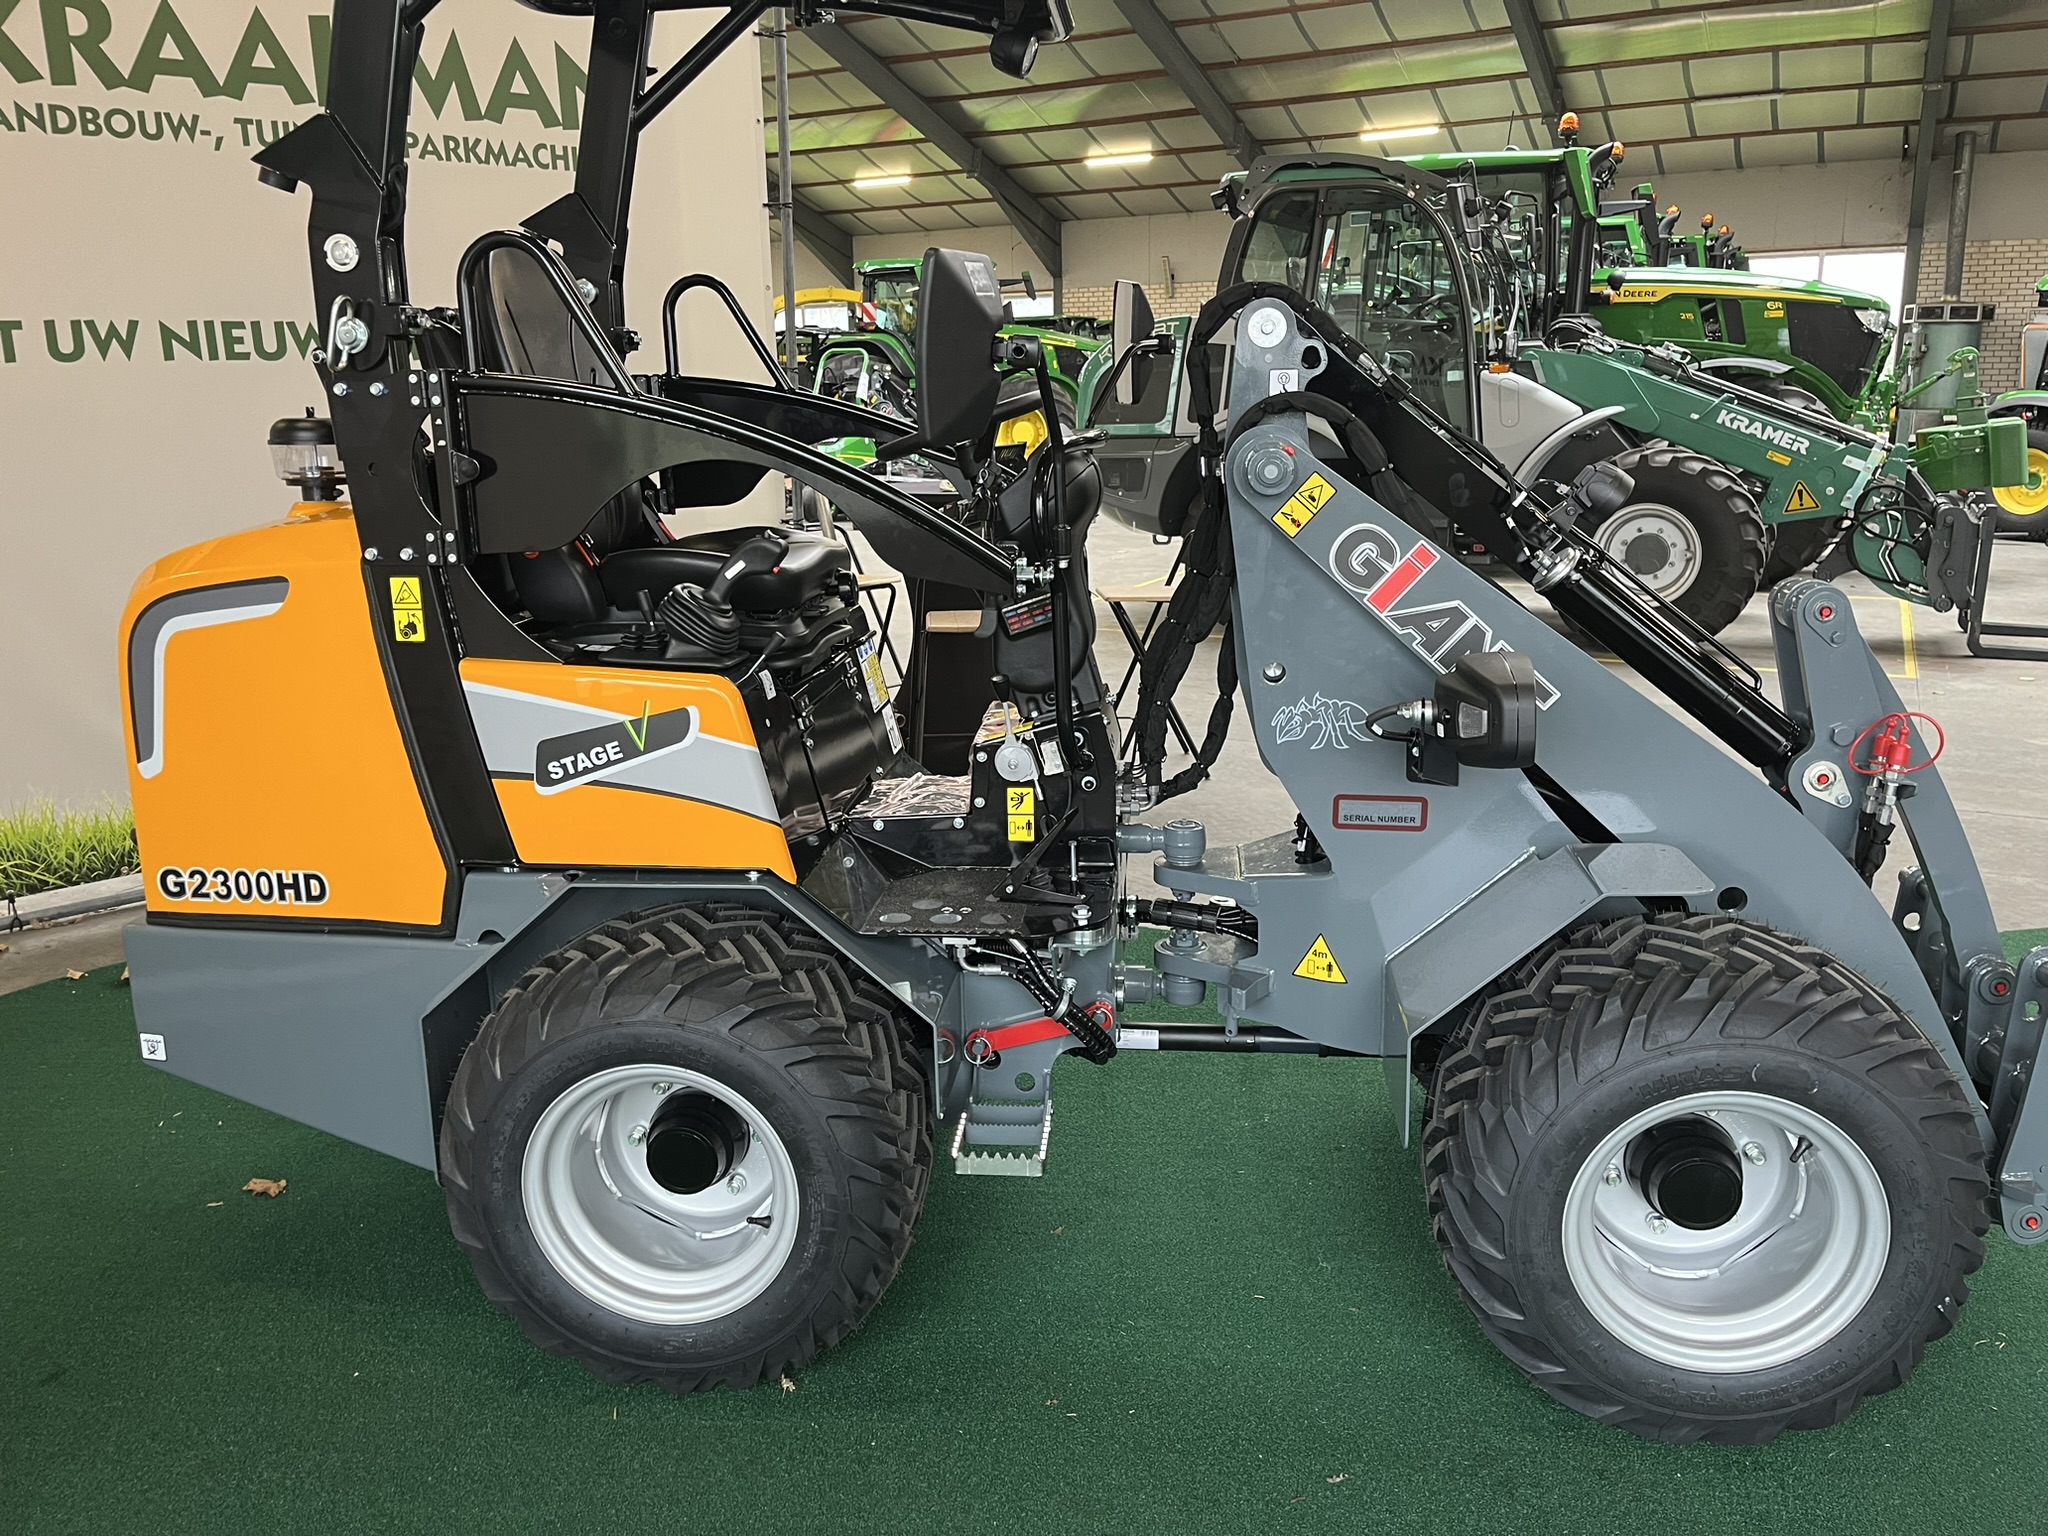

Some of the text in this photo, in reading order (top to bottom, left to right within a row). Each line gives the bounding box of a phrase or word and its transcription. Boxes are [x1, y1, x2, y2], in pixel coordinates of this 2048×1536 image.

[1623, 289, 1658, 298] DEERE
[1766, 300, 1783, 310] 6R
[43, 319, 139, 363] UW
[1716, 409, 1810, 455] KRAMER
[547, 740, 624, 780] STAGE
[1343, 814, 1416, 824] SERIAL NUMBER
[158, 867, 328, 904] G2300HD
[1312, 949, 1328, 959] 4m
[1638, 1066, 1744, 1100] MITAS
